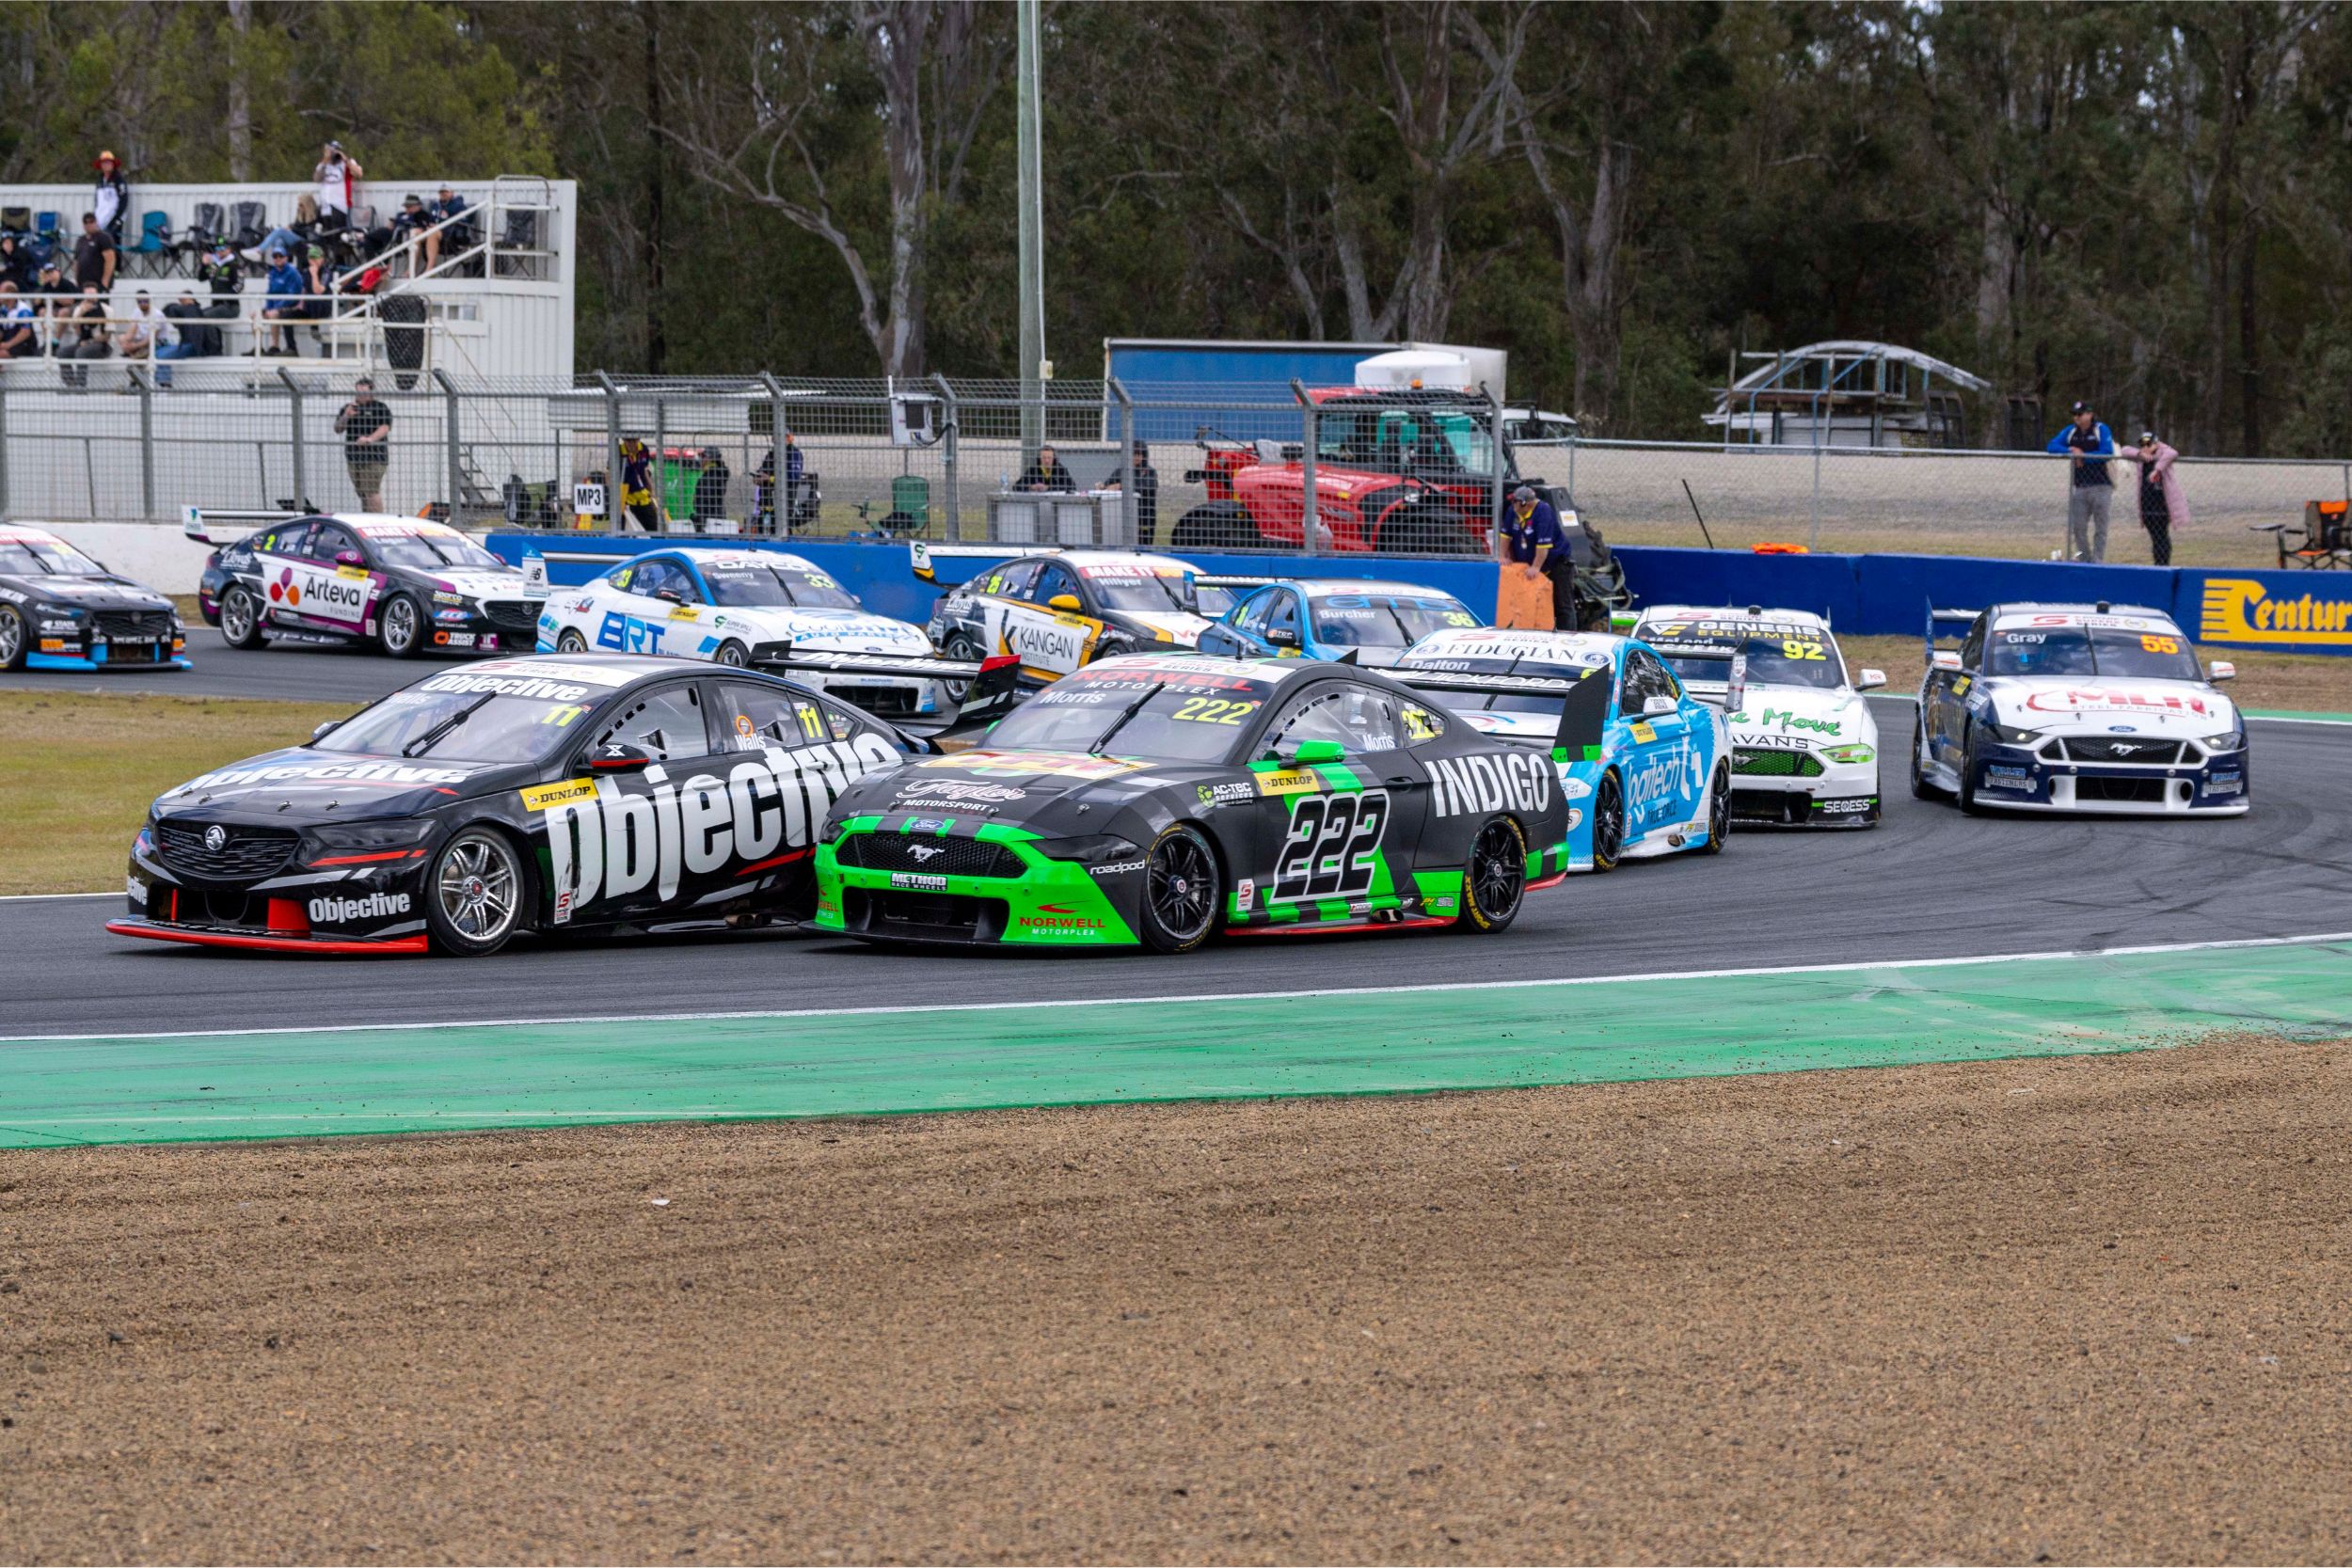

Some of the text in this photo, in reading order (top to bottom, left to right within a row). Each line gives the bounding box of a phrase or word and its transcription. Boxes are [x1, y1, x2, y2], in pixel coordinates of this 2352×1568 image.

[577, 487, 601, 506] MP3
[263, 534, 276, 551] 2
[712, 572, 755, 580] Sweeny
[803, 573, 835, 589] 33
[1098, 578, 1142, 588] Hillyer
[304, 576, 360, 608] Arteva
[1319, 610, 1375, 620] Burcher
[1440, 610, 1476, 628] 36
[596, 610, 666, 655] BRT
[1698, 621, 1820, 636] GENESIS
[1020, 626, 1074, 660] KANGAN
[2007, 633, 2047, 644] Gray
[2140, 634, 2179, 655] 55
[1446, 643, 1578, 662] FIDUCIAN
[1783, 641, 1827, 661] 92
[1409, 658, 1470, 672] Dalton
[421, 673, 589, 702] Objective
[1073, 670, 1253, 692] NORWELL
[1437, 672, 1567, 690] TICKFORD
[1039, 689, 1106, 705] Morris
[541, 704, 581, 727] 11
[1172, 697, 1255, 726] 222
[798, 707, 823, 738] 11
[1762, 706, 1842, 736] Move
[734, 733, 767, 751] Walls
[1362, 732, 1397, 752] Morris
[895, 778, 1026, 802] Taylor
[1212, 782, 1253, 796] AC-TEC
[1271, 775, 1313, 787] DUNLOP
[1423, 753, 1549, 818] INDIGO
[539, 785, 591, 804] DUNLOP
[902, 800, 991, 812] MOTORSPORT
[1270, 788, 1391, 904] 222
[1089, 859, 1146, 875] roadpod
[914, 883, 946, 892] WHEELS
[309, 892, 411, 924] Objective
[1019, 917, 1107, 928] NORWELL
[1032, 927, 1095, 936] MOTORPLEX
